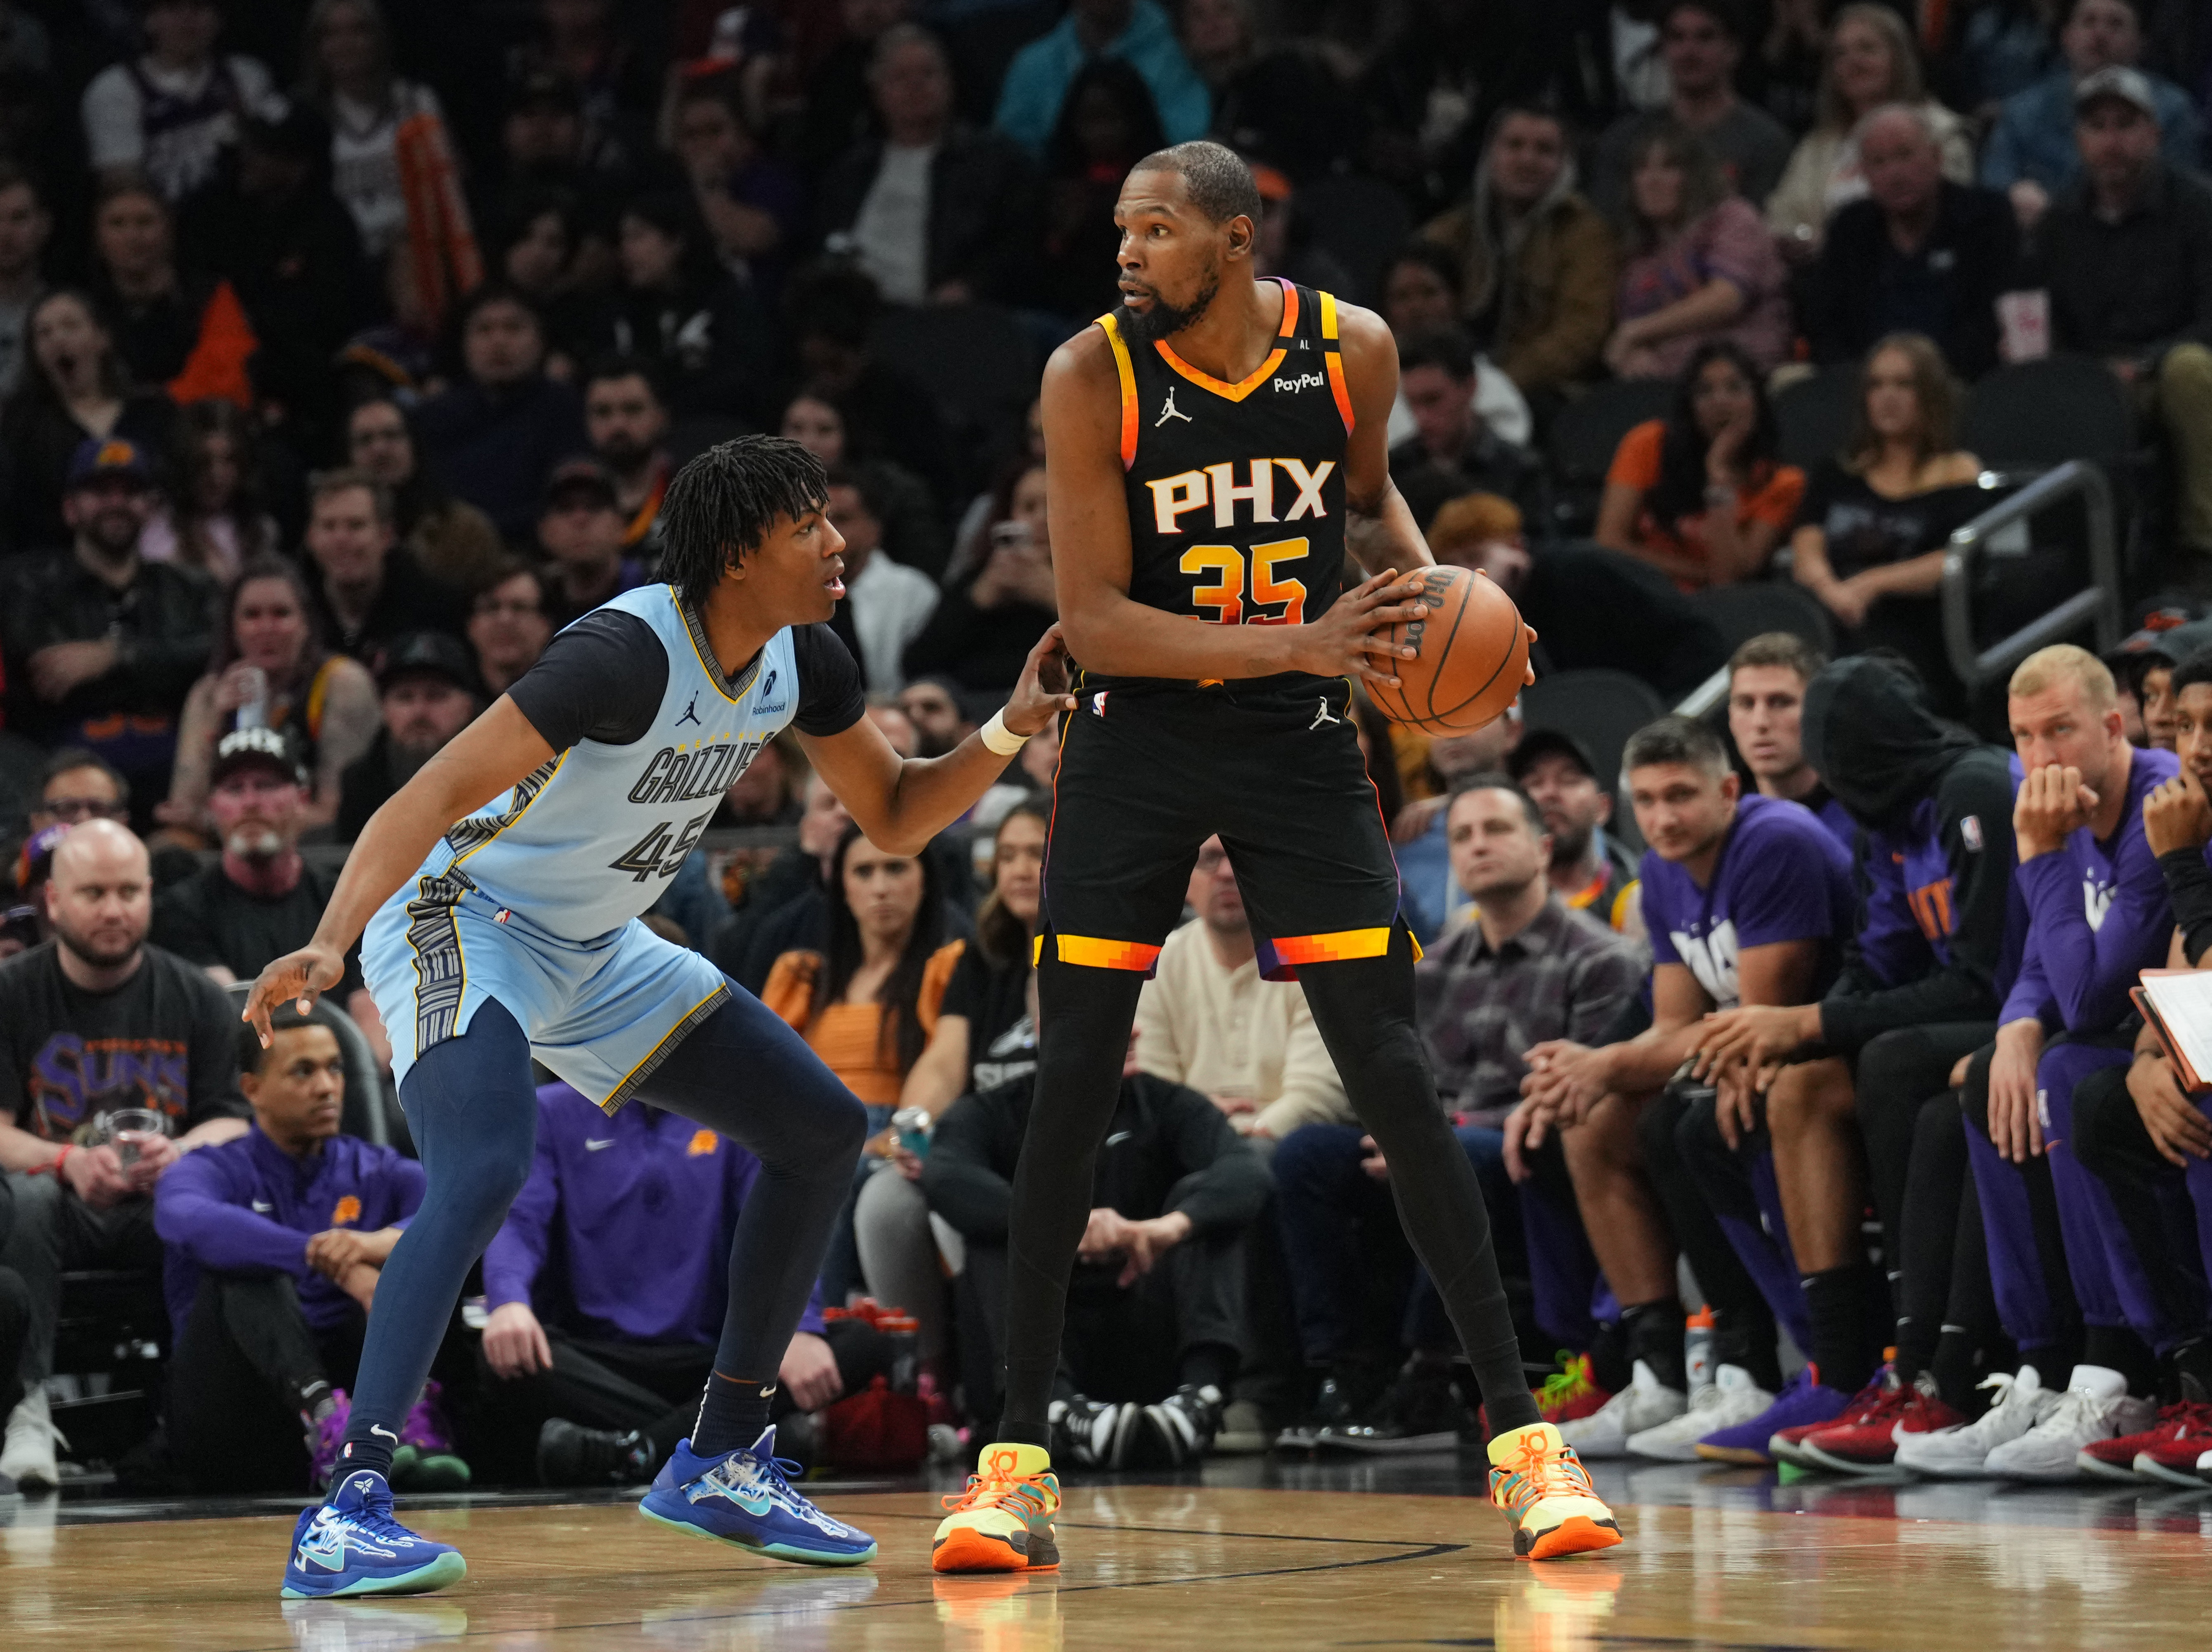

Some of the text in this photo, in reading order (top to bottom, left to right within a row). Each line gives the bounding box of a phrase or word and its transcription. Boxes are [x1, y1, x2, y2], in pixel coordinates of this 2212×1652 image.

[1300, 339, 1310, 350] AL
[1274, 371, 1324, 394] PayPal
[1145, 457, 1336, 534] PHX
[1179, 536, 1309, 625] 35
[1404, 570, 1460, 659] Wilon
[752, 702, 785, 716] Robinhood
[677, 731, 766, 753] MEMPHIS
[607, 807, 714, 882] 45
